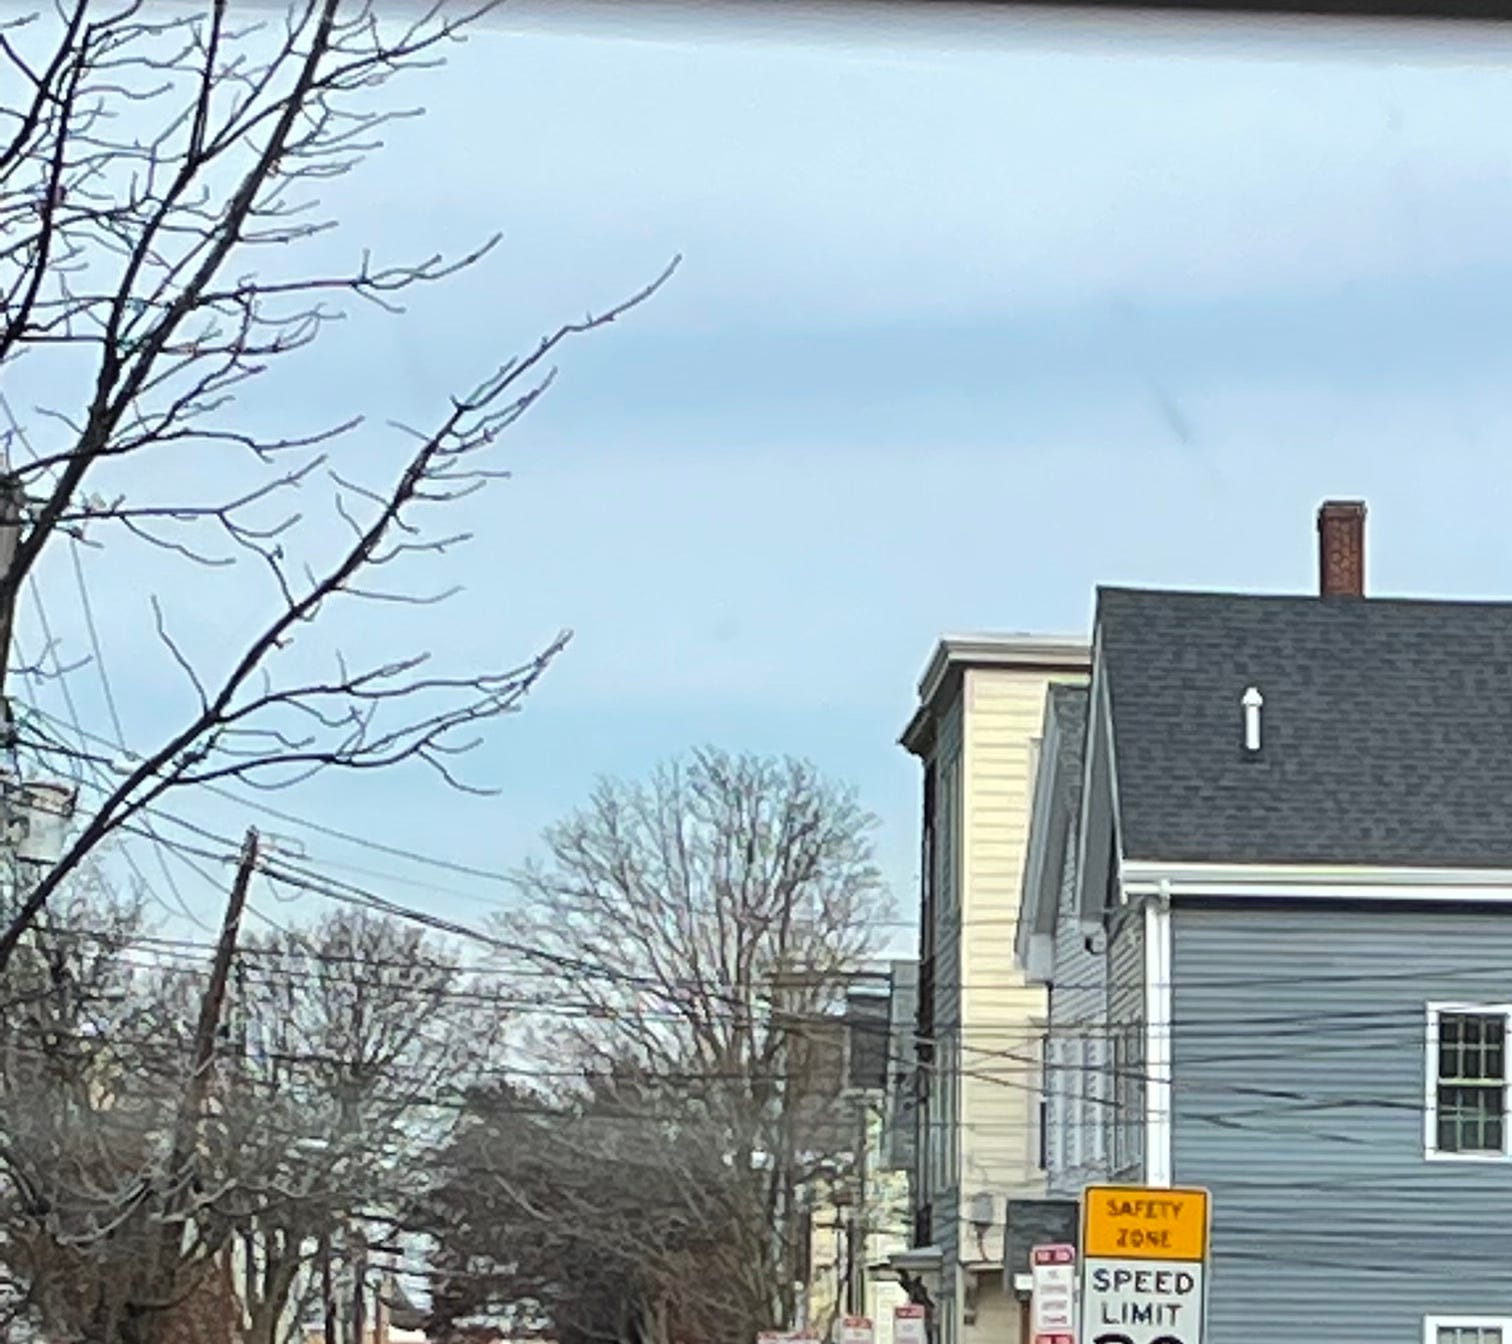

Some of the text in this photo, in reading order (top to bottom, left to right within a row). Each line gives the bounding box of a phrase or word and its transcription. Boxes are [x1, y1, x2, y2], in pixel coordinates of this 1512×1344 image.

[1106, 1199, 1184, 1220] SAFETY
[1116, 1228, 1172, 1249] ZONE
[1092, 1267, 1195, 1295] SPEED
[1101, 1301, 1184, 1326] LIMIT
